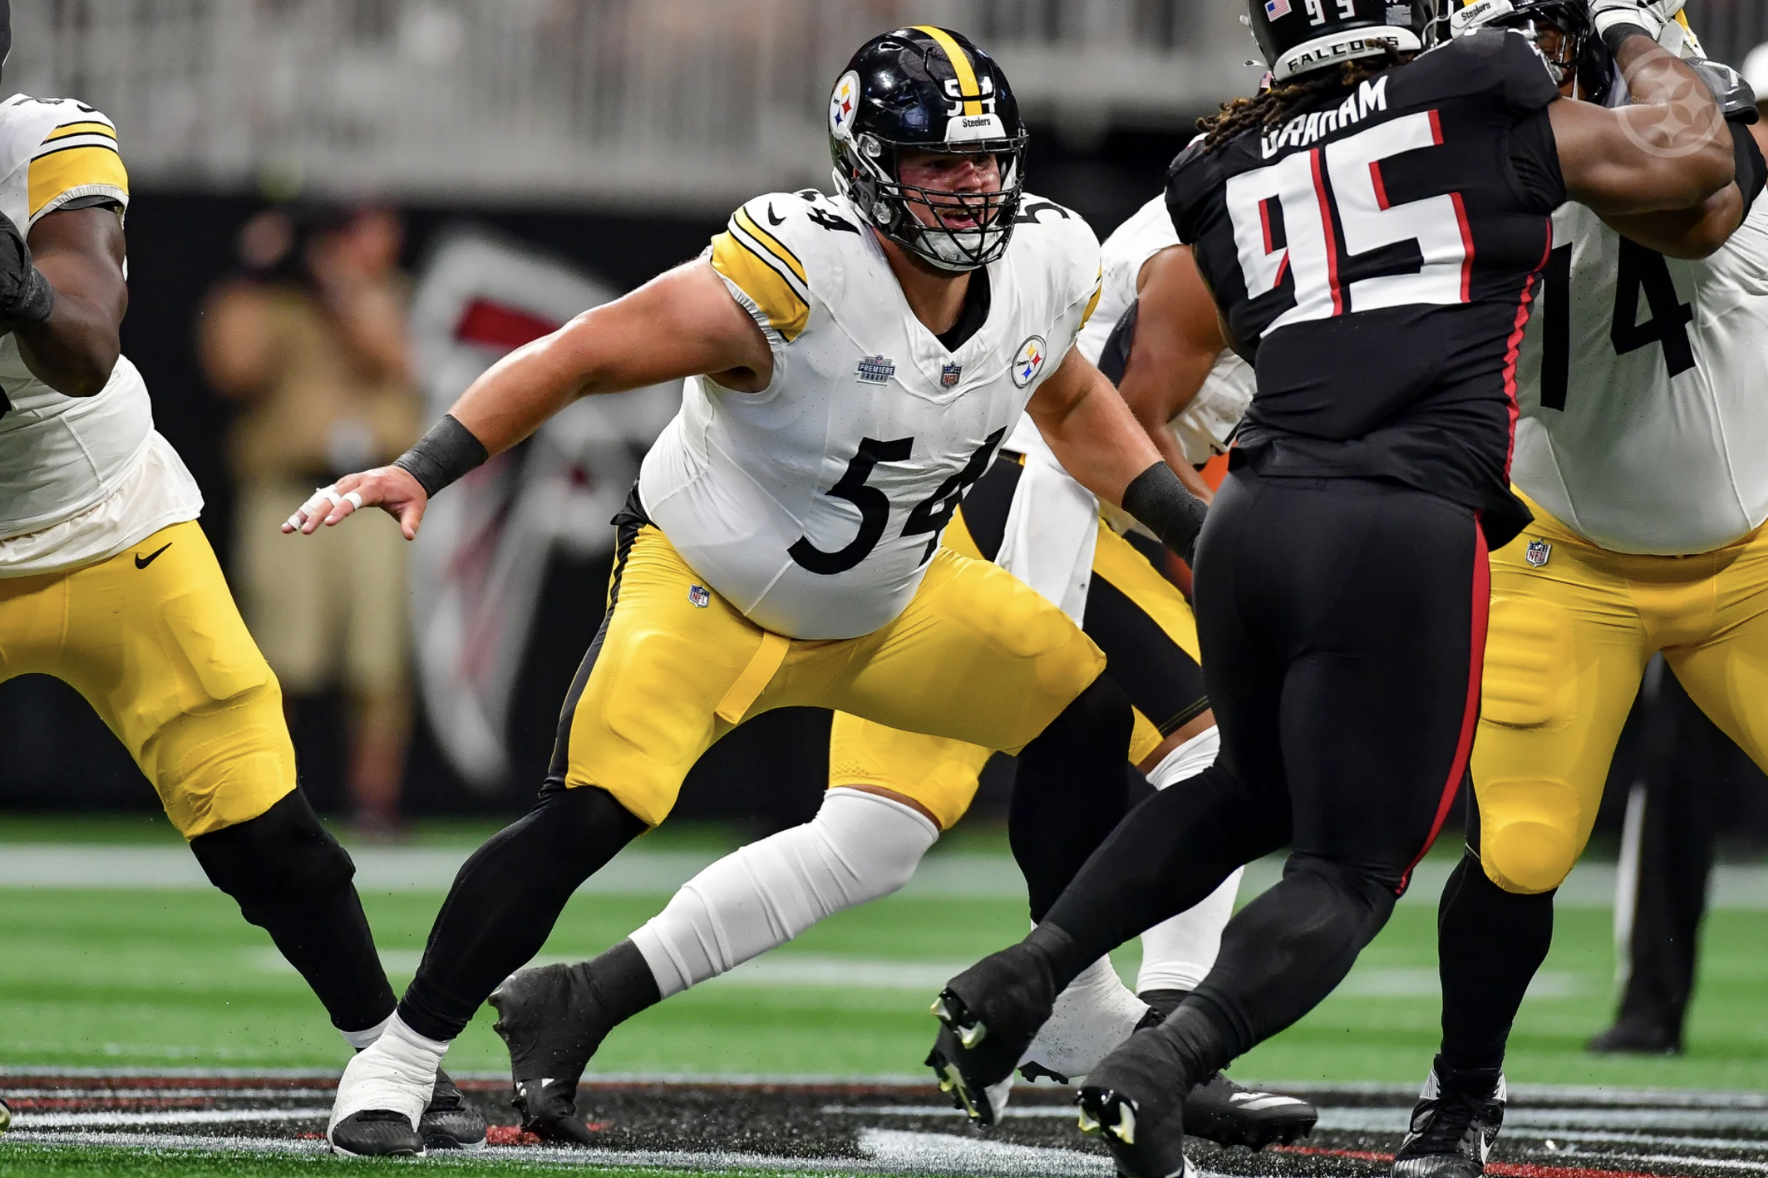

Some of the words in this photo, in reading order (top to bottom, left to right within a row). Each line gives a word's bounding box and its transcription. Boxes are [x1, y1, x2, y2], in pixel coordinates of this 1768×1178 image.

[1460, 2, 1491, 21] Steelers
[1287, 36, 1400, 72] FALCOS
[944, 76, 996, 117] 54
[962, 117, 991, 128] Steelers
[1226, 109, 1475, 339] 95
[1540, 235, 1697, 412] 14
[787, 425, 1008, 575] 54
